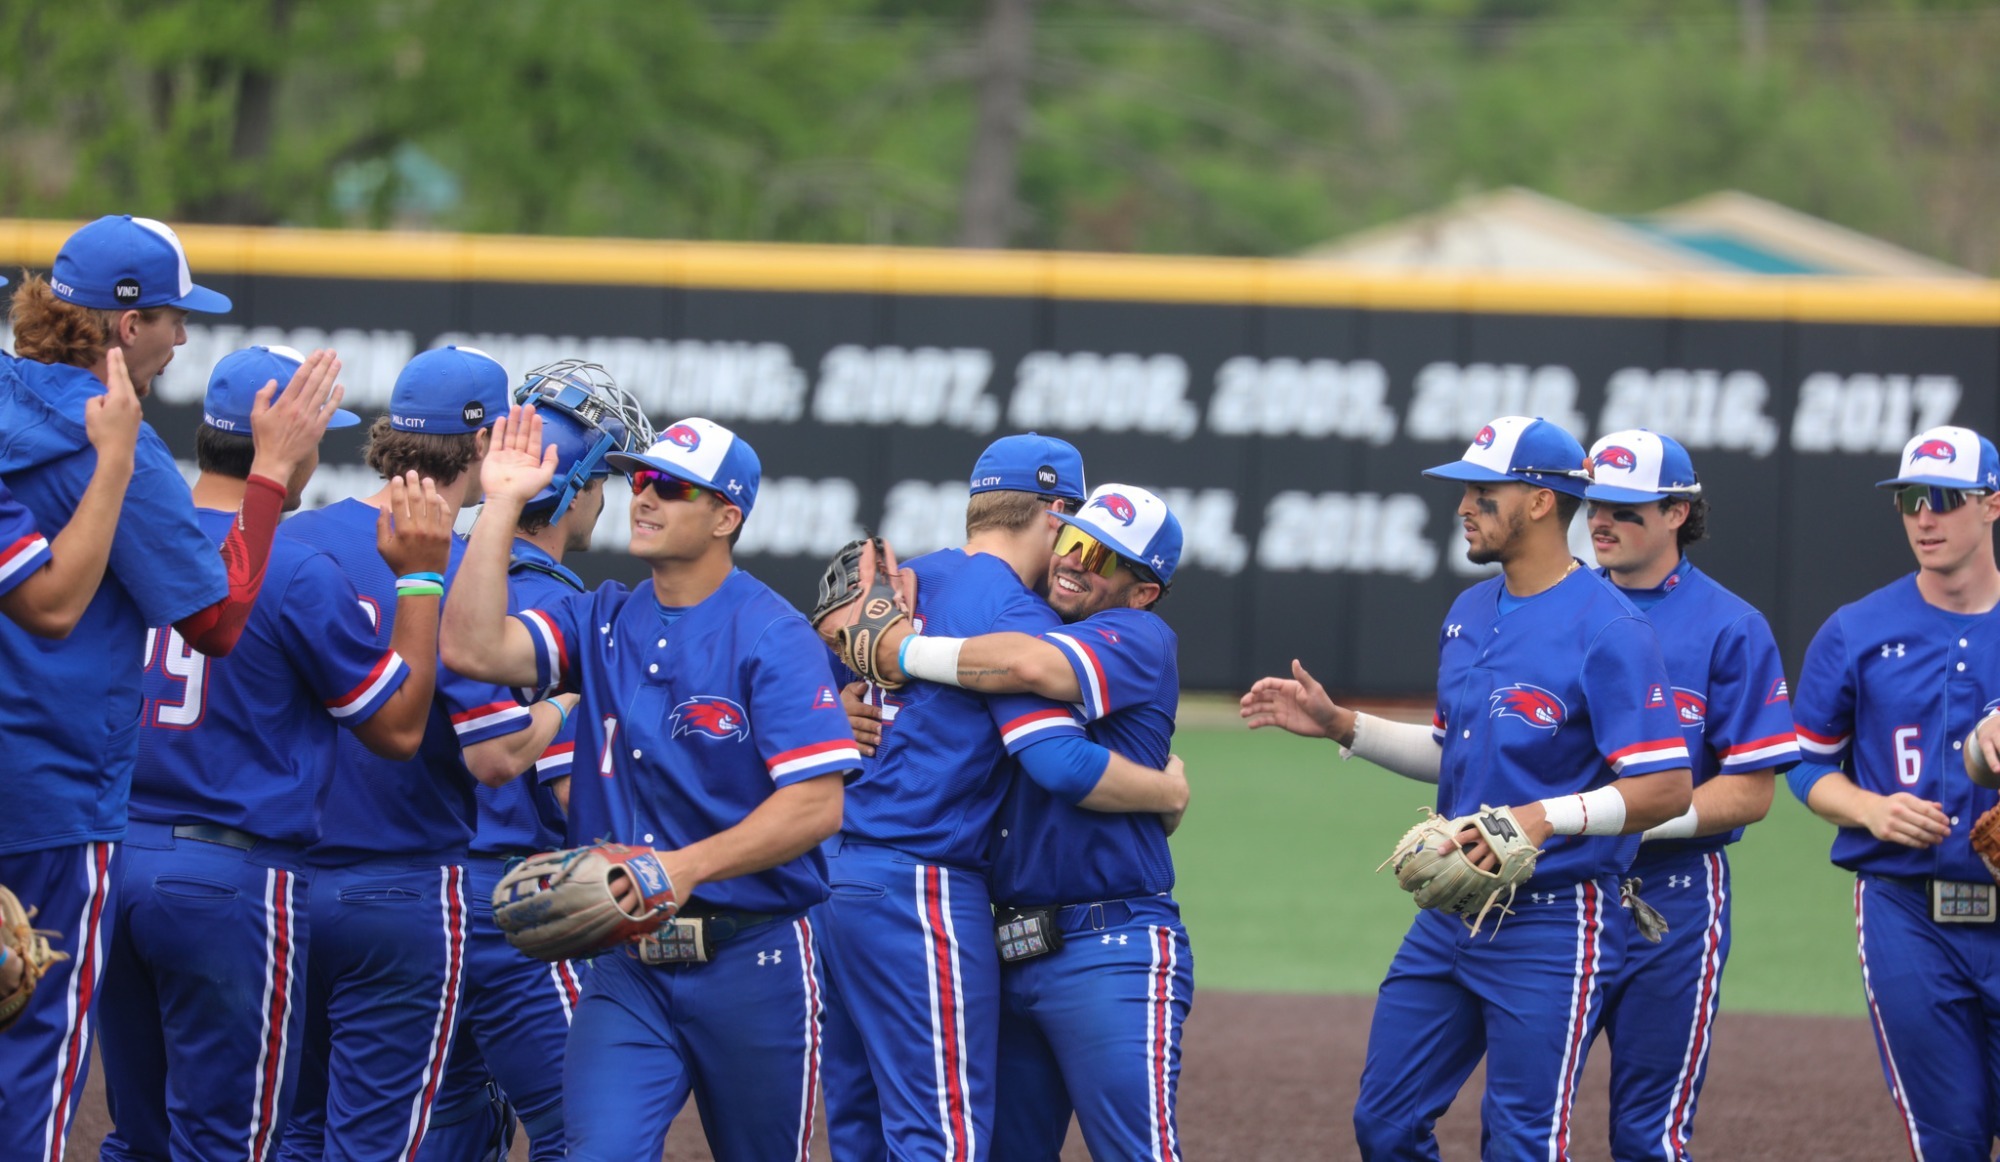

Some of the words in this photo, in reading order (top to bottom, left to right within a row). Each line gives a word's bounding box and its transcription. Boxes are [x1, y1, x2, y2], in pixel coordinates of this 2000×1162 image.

[57, 283, 74, 297] CITY
[116, 285, 139, 297] VINCI
[464, 407, 483, 420] VINCI
[216, 418, 235, 431] CITY
[405, 418, 426, 428] CITY
[982, 476, 1001, 487] CITY
[1038, 470, 1056, 484] VINCI
[857, 633, 867, 671] Wilson
[143, 625, 209, 729] 9
[599, 714, 619, 777] 1
[1893, 725, 1923, 787] 6
